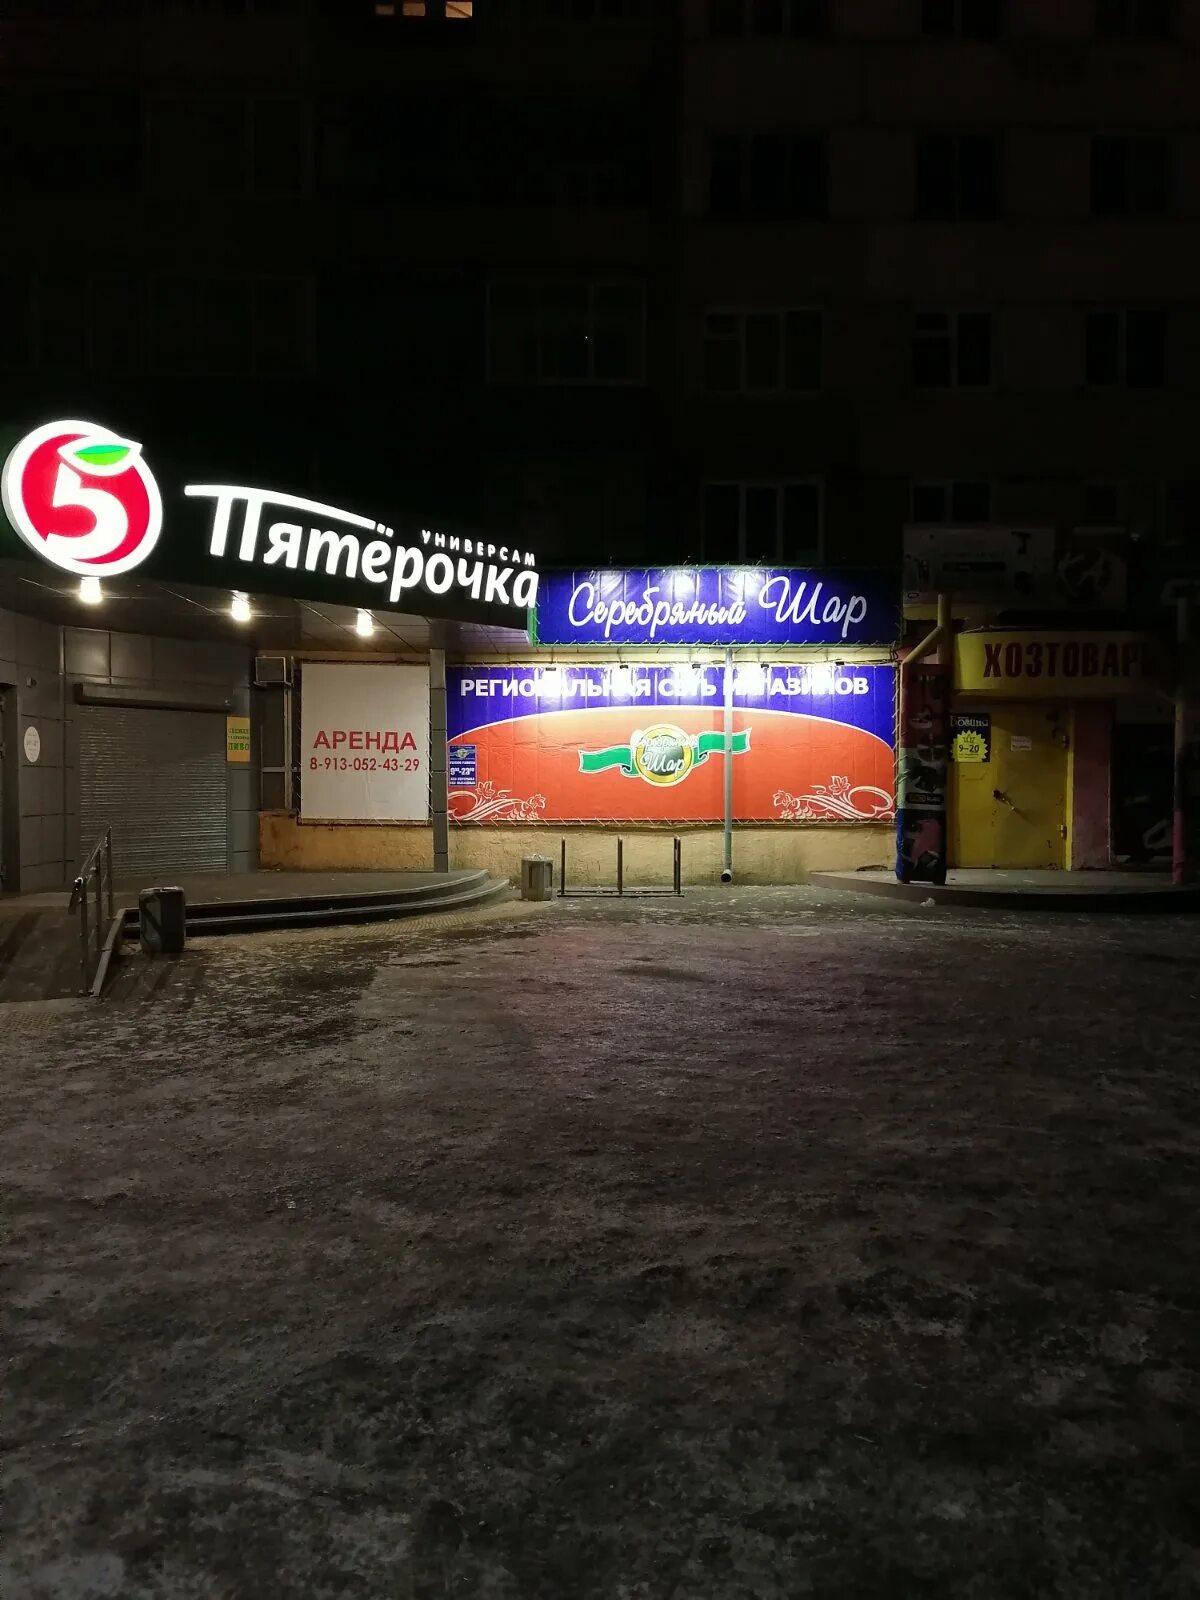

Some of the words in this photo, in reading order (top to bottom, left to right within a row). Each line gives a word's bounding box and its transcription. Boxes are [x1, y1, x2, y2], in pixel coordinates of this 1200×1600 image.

[184, 484, 540, 608] Пятёрочка
[421, 529, 536, 567] УНИВЕРСАМ
[568, 582, 747, 638] Серебряный
[758, 575, 867, 638] Шар
[313, 730, 417, 754] АРЕНДА
[309, 756, 420, 771] 8-913-052-43-29
